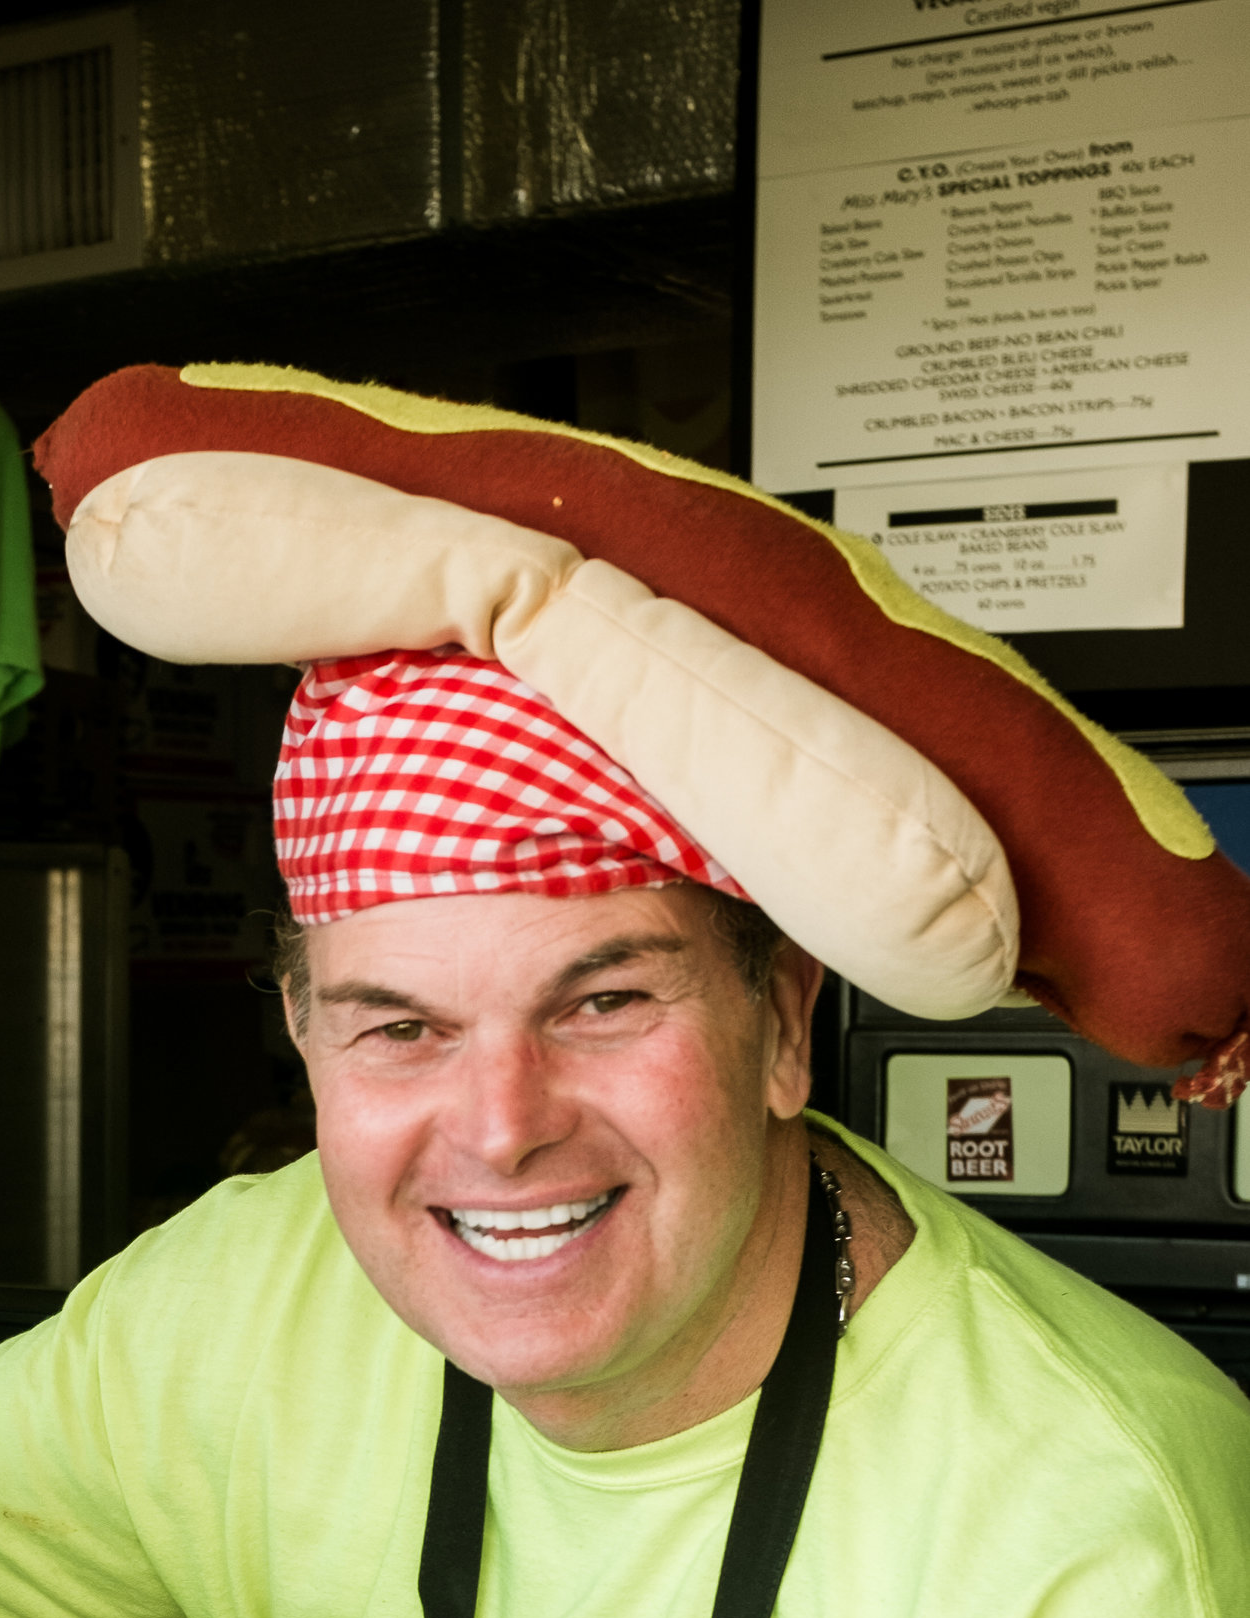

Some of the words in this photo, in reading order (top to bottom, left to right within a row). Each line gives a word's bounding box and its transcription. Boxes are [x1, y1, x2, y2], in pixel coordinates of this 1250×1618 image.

[1088, 140, 1133, 158] from
[937, 175, 1011, 198] SPECIAL
[1017, 161, 1112, 187] TOPPINGS
[894, 339, 966, 359] GROUND
[1035, 328, 1080, 345] BEAN
[1081, 323, 1125, 341] CHILI
[920, 354, 998, 375] CRUMBLED
[1040, 344, 1094, 363] CHEESE
[1133, 351, 1190, 370] CHEESE
[863, 412, 940, 433] CRUMBLED
[941, 406, 997, 425] BACON
[1007, 401, 1064, 419] BACON
[950, 1140, 1008, 1159] ROOT
[1112, 1135, 1183, 1157] TAYLOR
[951, 1158, 1008, 1177] BEER
